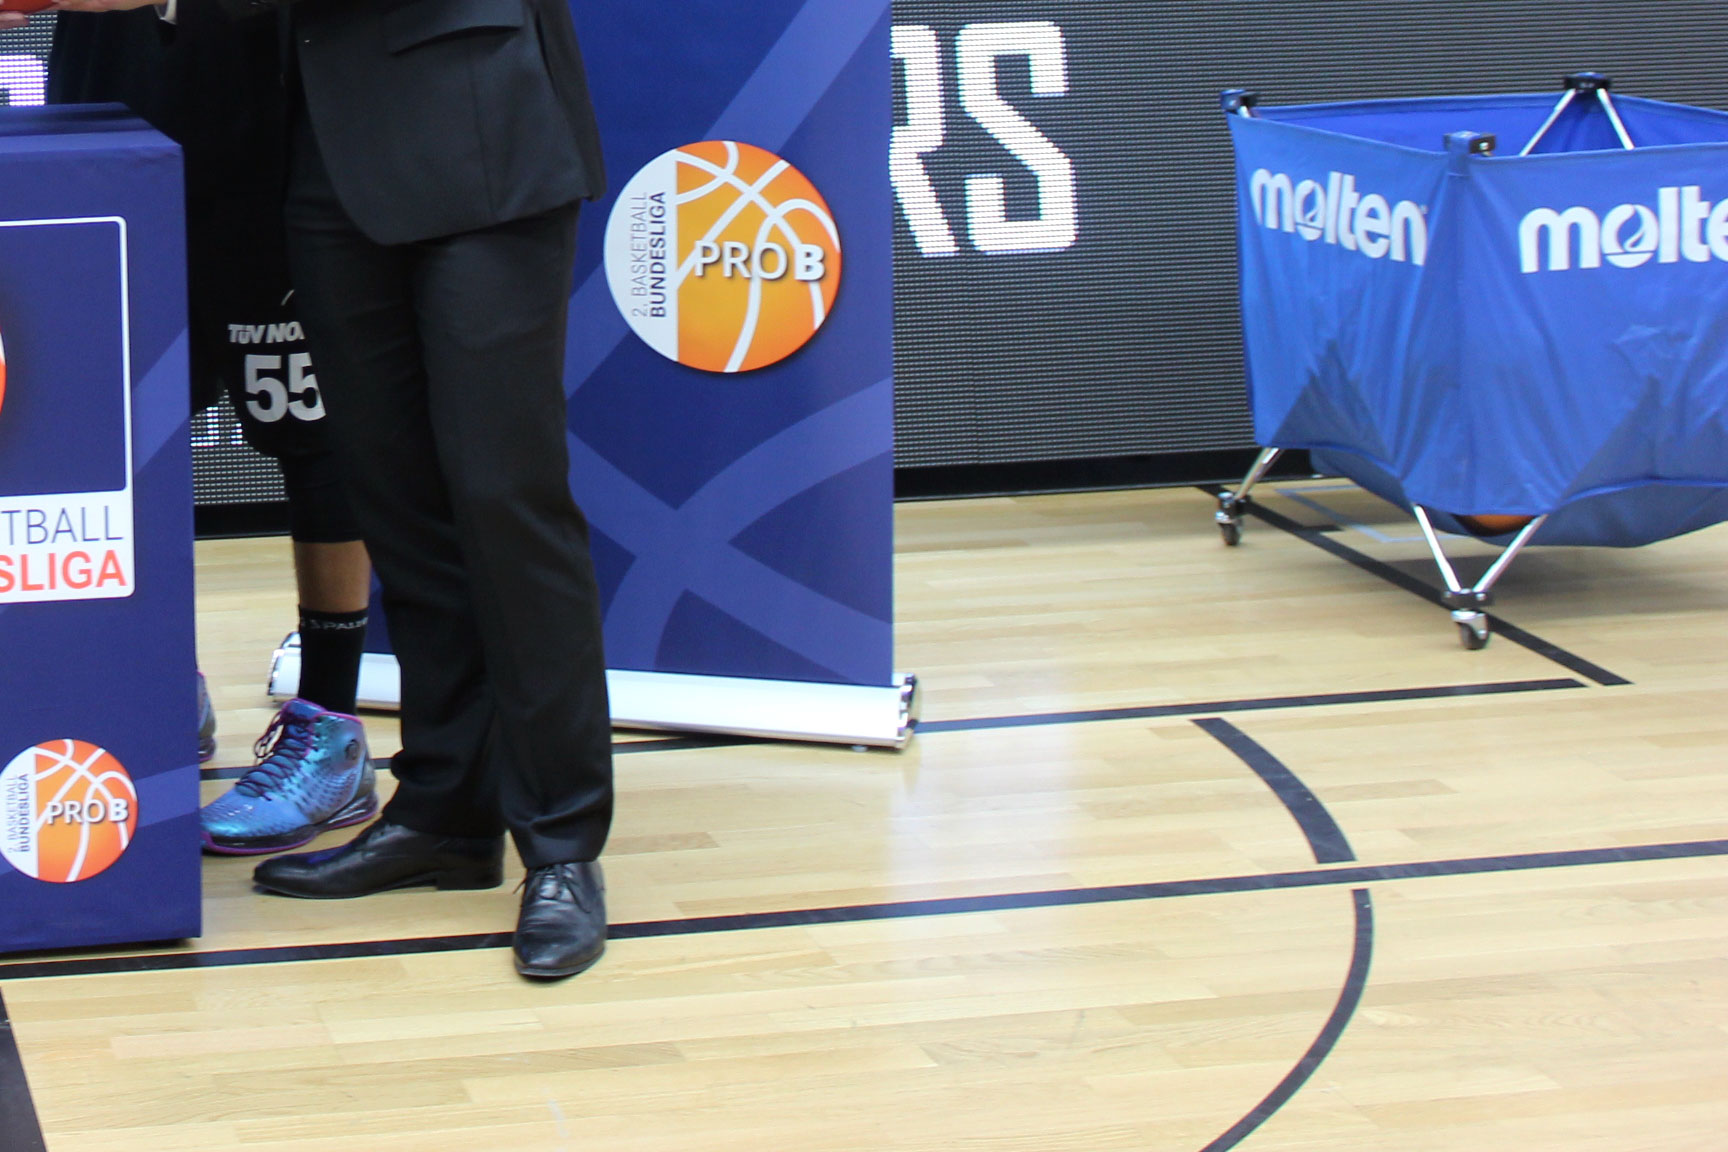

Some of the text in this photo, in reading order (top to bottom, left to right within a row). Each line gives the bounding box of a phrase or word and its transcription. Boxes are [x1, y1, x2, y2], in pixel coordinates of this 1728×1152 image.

[631, 192, 648, 297] BASKETBALL
[649, 191, 666, 318] BUNDESLIGA
[1250, 168, 1428, 266] molten
[245, 352, 327, 423] 55
